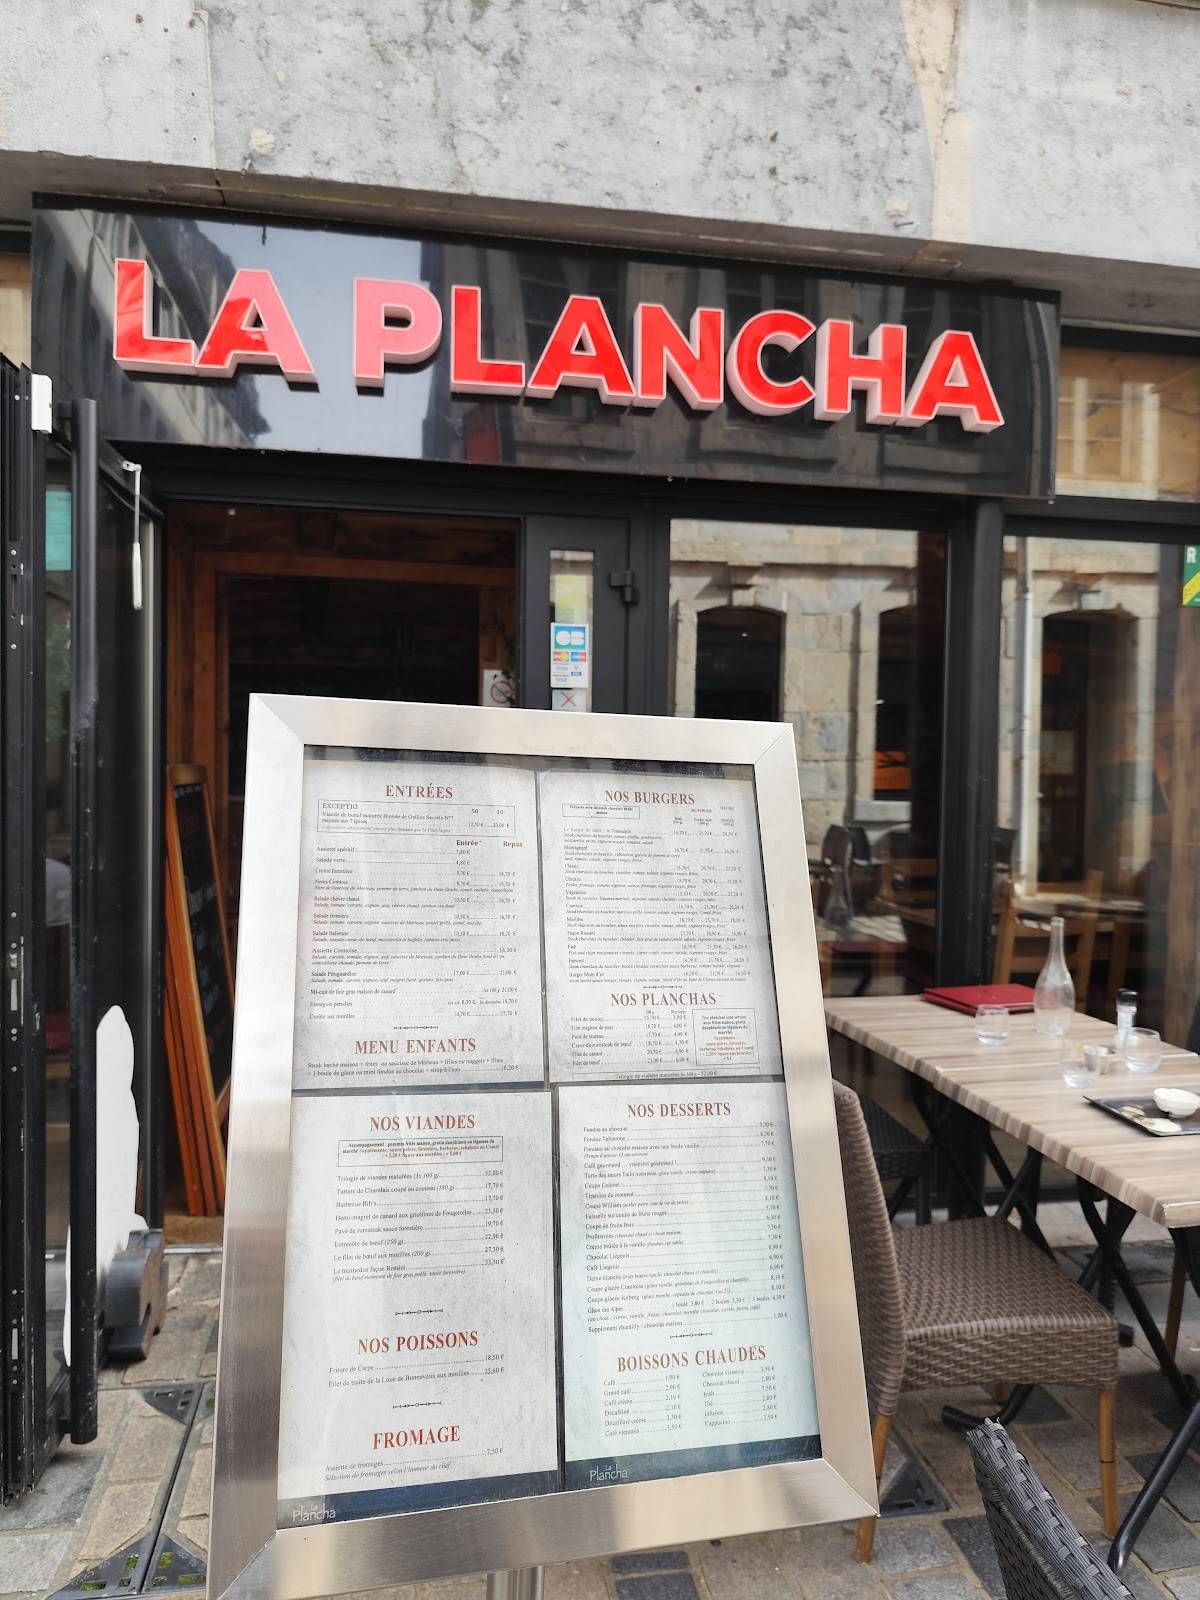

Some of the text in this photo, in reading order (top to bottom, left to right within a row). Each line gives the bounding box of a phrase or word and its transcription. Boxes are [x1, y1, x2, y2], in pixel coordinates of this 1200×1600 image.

[114, 256, 1005, 433] LA PLANCHA
[385, 783, 453, 798] ENTRÉES
[605, 790, 695, 805] NOS BURGERS
[611, 992, 717, 1006] NOS PLANCHAS
[355, 1038, 476, 1054] MENU ENFANTS
[627, 1102, 731, 1118] NOS DESSERTS
[370, 1114, 475, 1131] NOS VIANDES
[358, 1330, 478, 1354] NOS POISSONS
[617, 1344, 766, 1372] BOISSONS CHAUDES
[328, 1380, 342, 1388] Filet
[372, 1425, 461, 1450] FROMAGE
[326, 1464, 349, 1472] Assiette
[357, 1461, 384, 1470] fromages
[438, 1463, 451, 1471] chef
[589, 1463, 628, 1482] Plancha
[292, 1502, 336, 1522] Plancha
